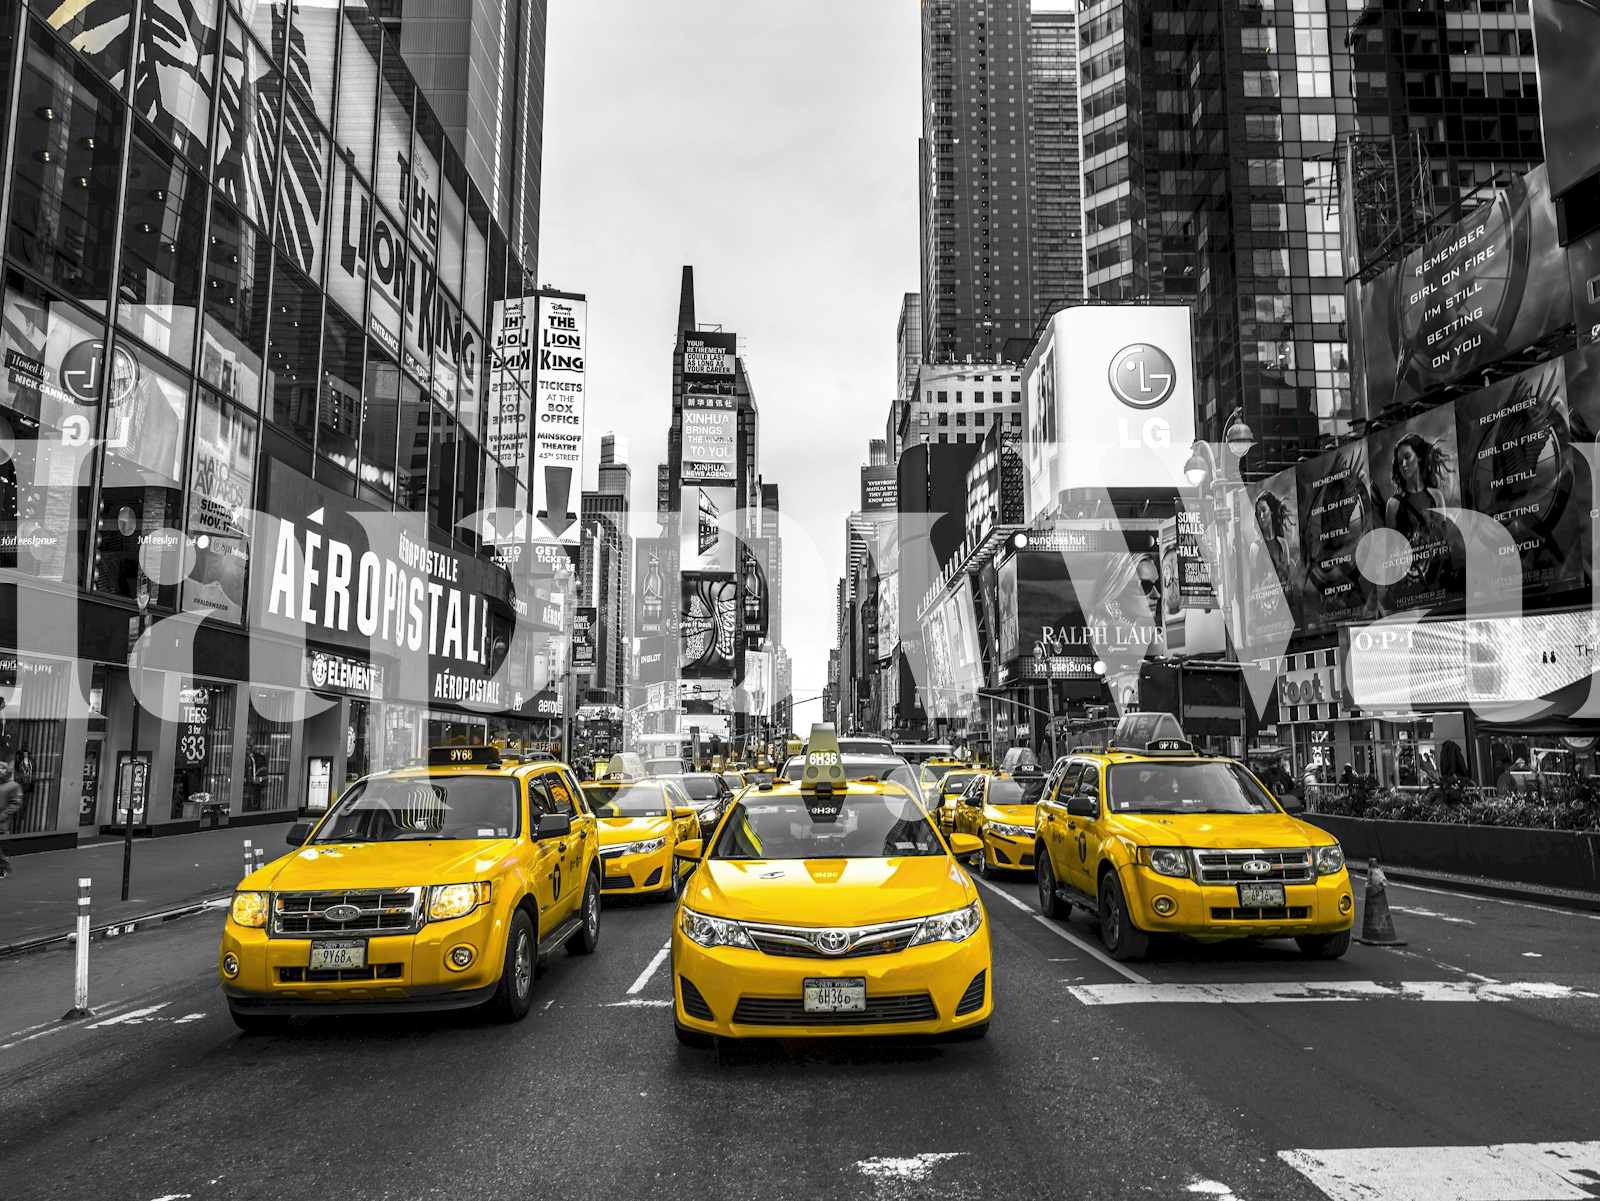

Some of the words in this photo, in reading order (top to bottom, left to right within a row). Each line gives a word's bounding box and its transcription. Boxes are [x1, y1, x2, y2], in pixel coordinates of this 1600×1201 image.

[1415, 224, 1485, 278] REMEMBER
[1410, 280, 1438, 305] GIRL
[1441, 267, 1460, 286] ON
[1465, 245, 1495, 272] FIRE
[1424, 304, 1441, 322] I'M
[1445, 281, 1482, 309] STILL
[548, 315, 575, 328] THE
[1427, 306, 1483, 346] BETTING
[371, 317, 399, 353] ENTRANCE
[544, 329, 580, 348] LION
[686, 346, 726, 354] RETIREMENT
[1432, 353, 1450, 368] ON
[1454, 335, 1482, 356] YOU
[12, 354, 39, 373] Hosted
[540, 349, 584, 371] KING
[15, 374, 37, 390] NICK
[39, 384, 76, 404] CANNON
[539, 380, 583, 393] TICKETS
[546, 394, 557, 402] AT
[560, 394, 575, 403] THE
[548, 403, 573, 414] BOX
[1479, 397, 1538, 426] REMEMBER
[541, 413, 579, 425] OFFICE
[685, 413, 730, 424] XINHUA
[537, 432, 581, 442] MINSKOFF
[685, 426, 722, 435] BRINGS
[1118, 417, 1171, 449] LG
[687, 435, 702, 443] THE
[1478, 446, 1501, 460] GIRL
[1502, 438, 1519, 451] ON
[1521, 431, 1545, 446] FIRE
[541, 442, 577, 452] THEATRE
[690, 446, 705, 457] TO
[708, 446, 731, 457] YOU
[556, 453, 579, 461] STREET
[693, 463, 726, 471] XINHUA
[1312, 469, 1351, 489] REMEMBER
[1490, 477, 1504, 489] I'M
[1506, 469, 1537, 485] STILL
[1311, 507, 1327, 517] GIRL
[1327, 503, 1339, 512] ON
[1339, 496, 1355, 508] FIRE
[1493, 503, 1540, 523] BETTING
[1177, 511, 1201, 523] SOME
[1178, 523, 1204, 535] WALLS
[1319, 533, 1330, 541] I'M
[1331, 527, 1350, 539] STILL
[1029, 534, 1068, 548] sunglass
[1070, 535, 1086, 546] hut
[1179, 534, 1195, 546] CAN
[1498, 544, 1515, 556] ON
[1516, 538, 1540, 553] YOU
[398, 529, 459, 584] AÉROPOSTALE
[535, 545, 558, 555] GET
[1179, 545, 1199, 557] TALK
[537, 555, 571, 564] TICKETS
[1321, 554, 1352, 569] BETTING
[1382, 551, 1430, 570] CATCHING
[1433, 545, 1454, 557] FIRE
[1324, 587, 1336, 596] ON
[1336, 583, 1352, 594] YOU
[573, 615, 588, 623] SOME
[573, 622, 591, 630] WALLS
[573, 635, 586, 643] TALK
[1041, 626, 1108, 645] RALPH
[640, 653, 661, 664] INGLOT
[328, 660, 377, 692] ELEMENT
[434, 668, 501, 705] AÉROPOSTALE
[1278, 673, 1325, 704] Foot
[184, 706, 207, 724] TEES
[187, 725, 192, 734] 3
[193, 725, 201, 735] for
[181, 735, 205, 760] $33
[1158, 740, 1179, 750] 6P76
[451, 749, 473, 761] 9Y68
[810, 752, 838, 766] 6H36
